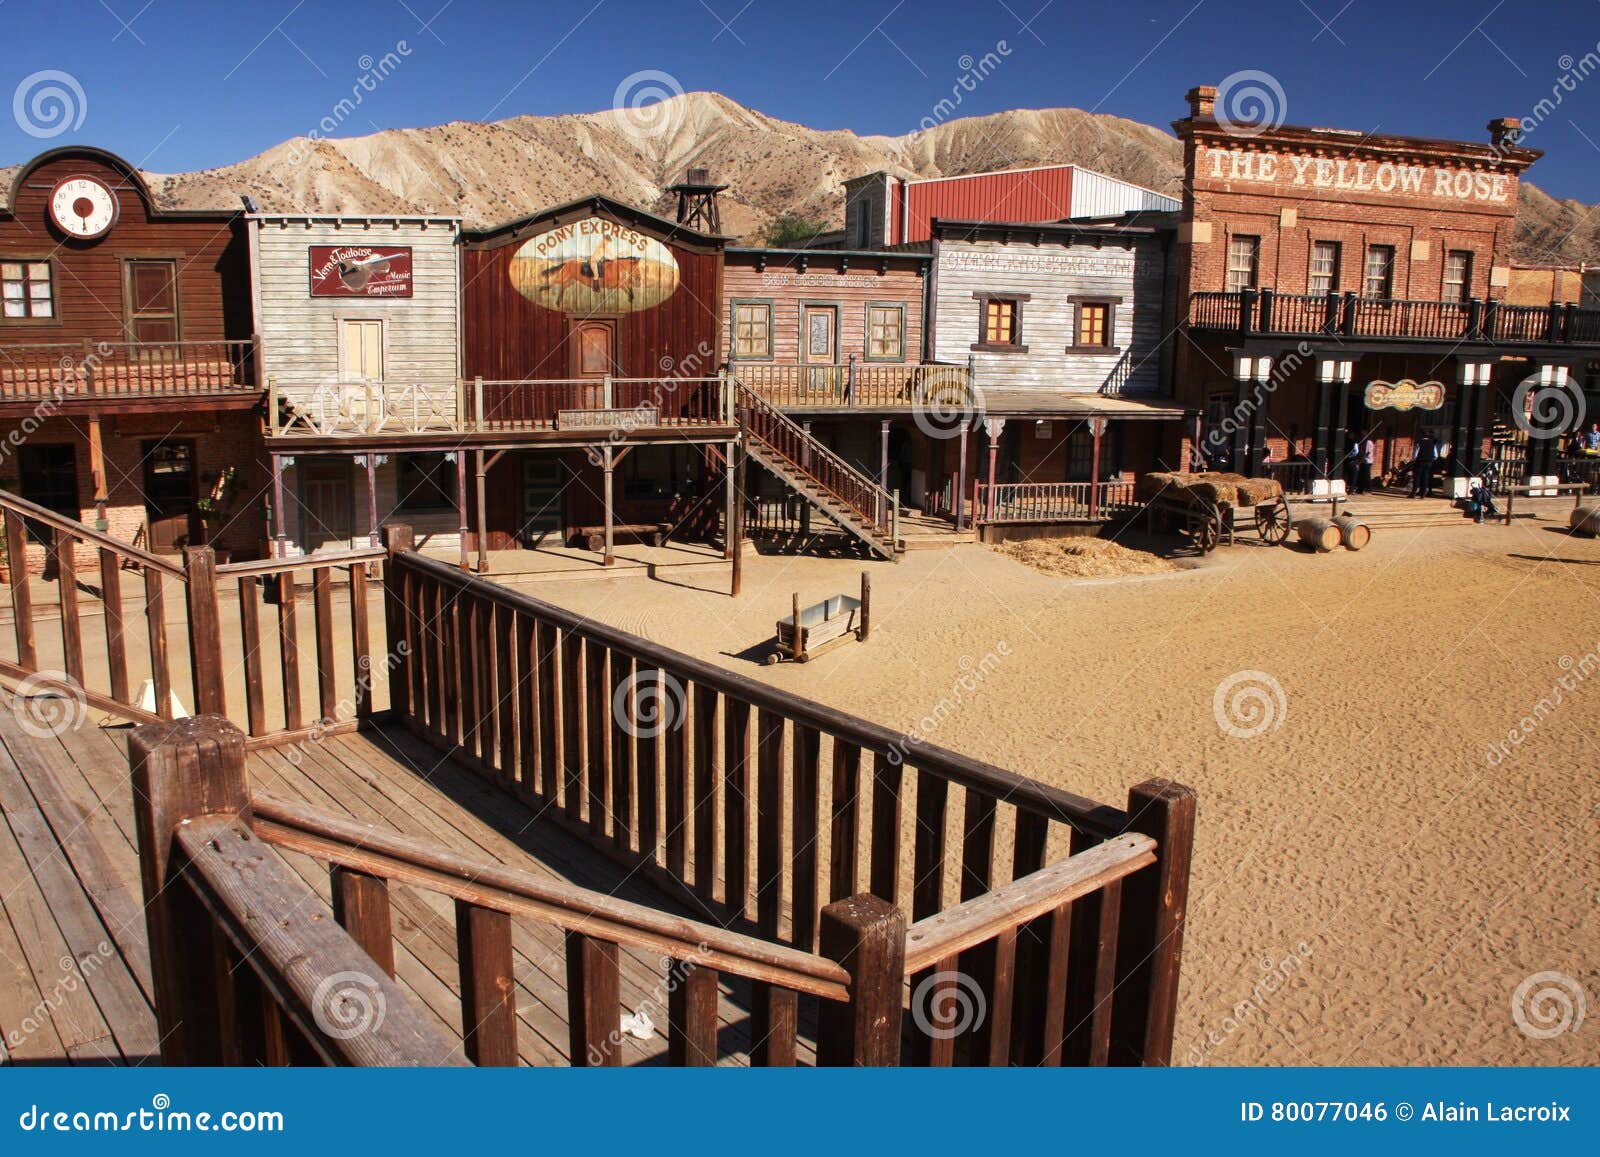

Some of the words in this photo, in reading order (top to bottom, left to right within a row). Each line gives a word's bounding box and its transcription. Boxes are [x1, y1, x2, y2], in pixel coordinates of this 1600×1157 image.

[1206, 150, 1278, 182] THE
[1292, 156, 1427, 192] YELLOW
[1432, 168, 1509, 201] ROSE
[537, 225, 576, 256] PONY
[580, 221, 648, 252] EXPRESS
[367, 283, 407, 295] Emporium
